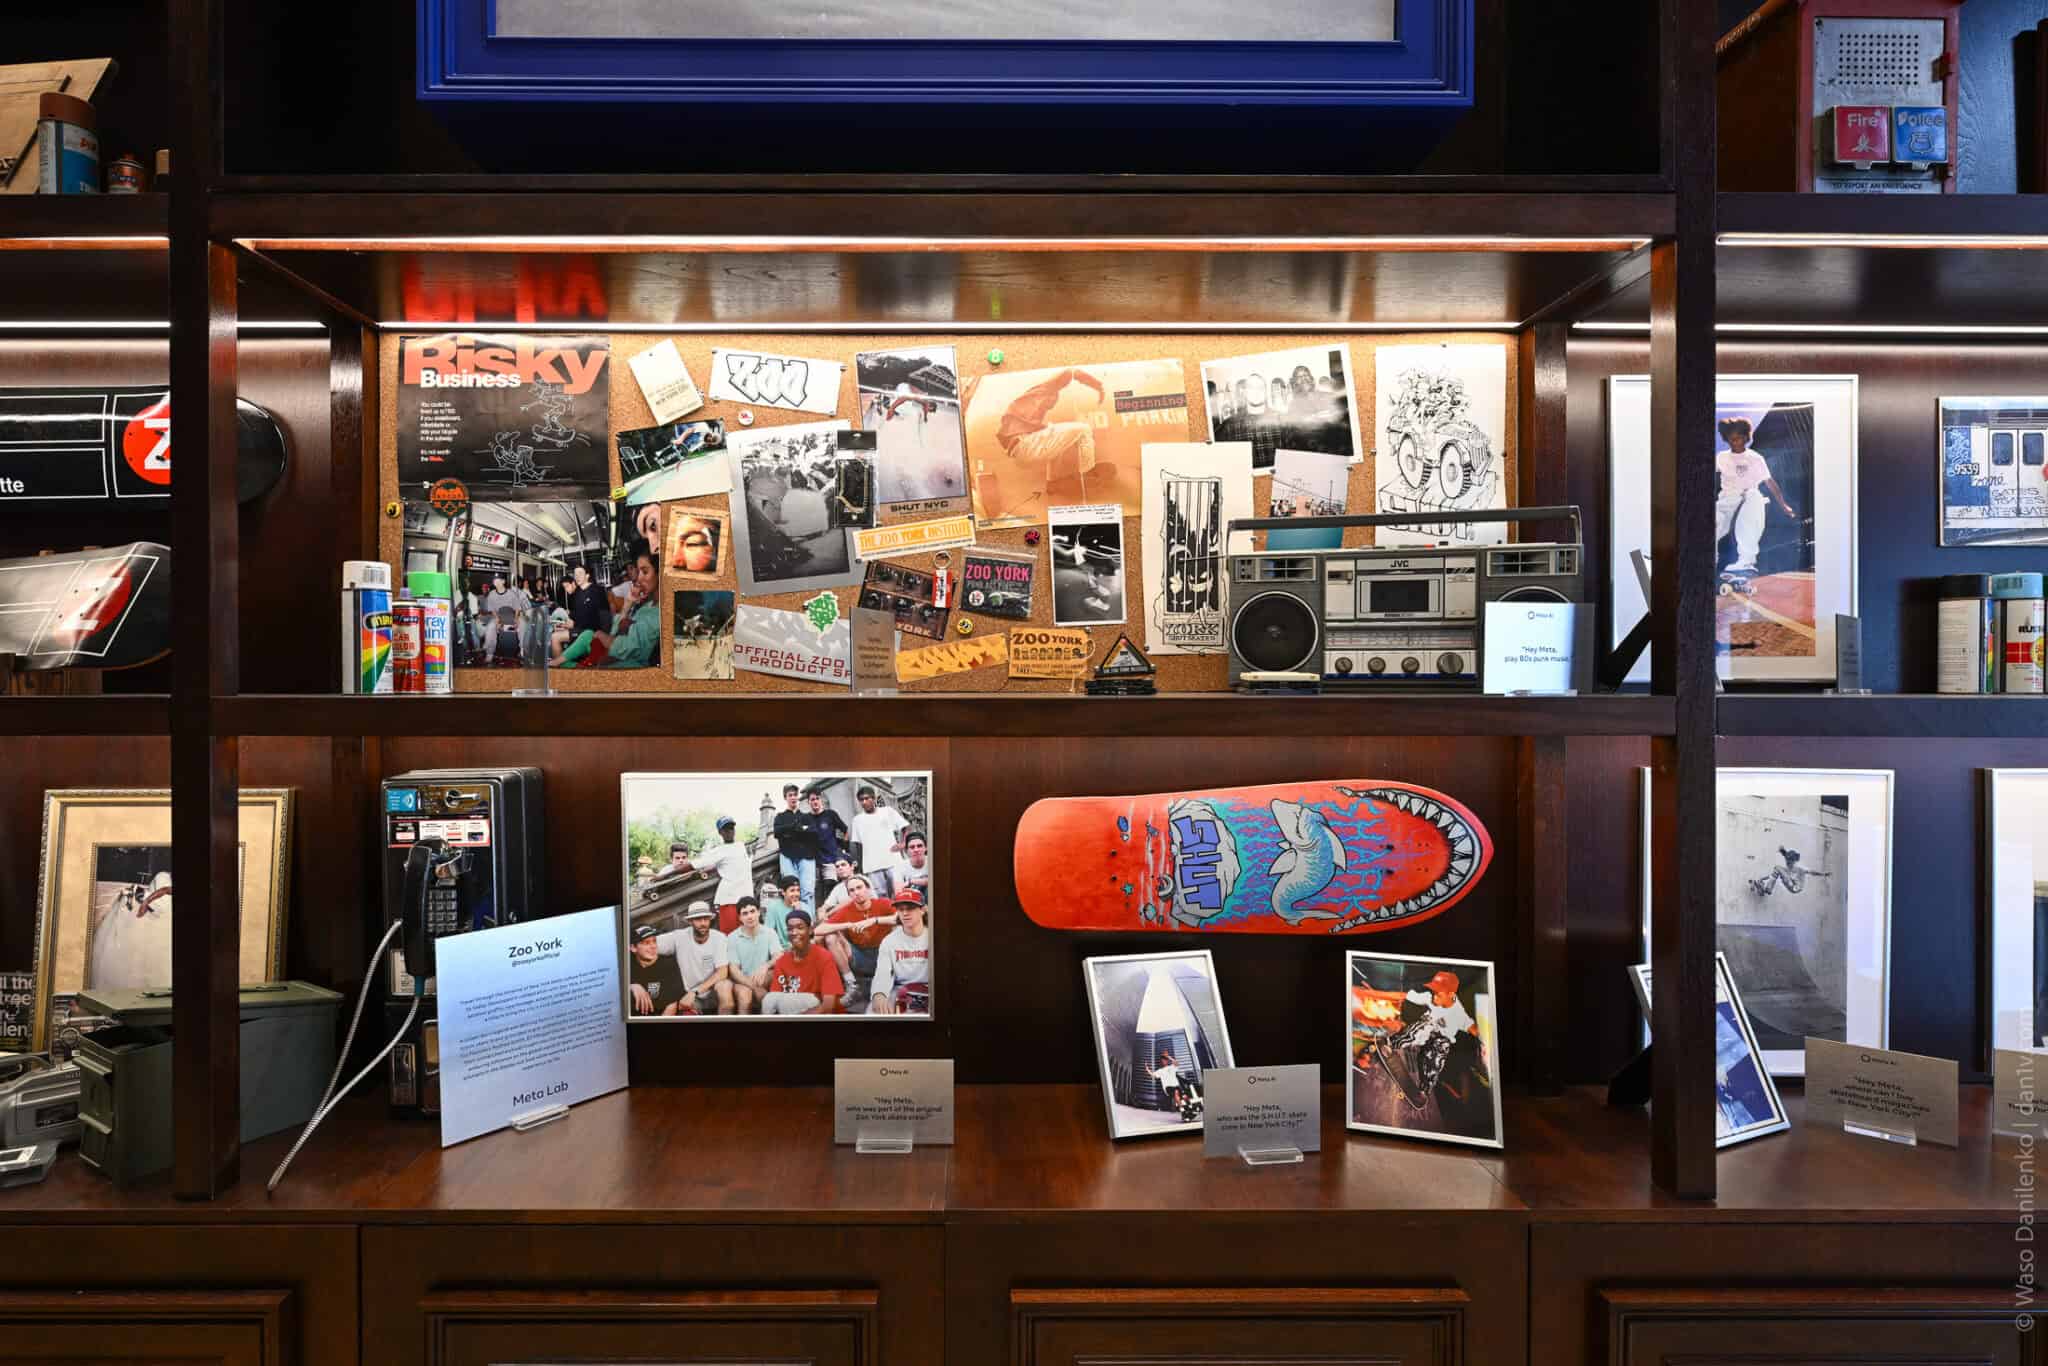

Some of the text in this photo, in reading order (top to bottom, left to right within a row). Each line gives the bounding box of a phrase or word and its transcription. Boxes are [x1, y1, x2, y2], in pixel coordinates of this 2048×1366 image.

[1847, 113, 1878, 127] Fire
[1897, 111, 1944, 127] Police
[404, 336, 608, 394] Risky
[420, 369, 521, 388] Business
[1954, 463, 1979, 475] 9539
[890, 500, 949, 512] SHUT NYC
[965, 564, 1030, 582] ZOO YORK
[1390, 560, 1409, 568] JVC
[1165, 623, 1219, 635] YORK
[1013, 633, 1083, 645] ZOO YORK
[734, 644, 845, 668] OFFICIAL ZOO
[750, 656, 828, 676] PRODUCT
[1172, 815, 1222, 909] SHUT
[508, 936, 563, 958] Zoo York
[512, 1080, 569, 1107] Meta Lab
